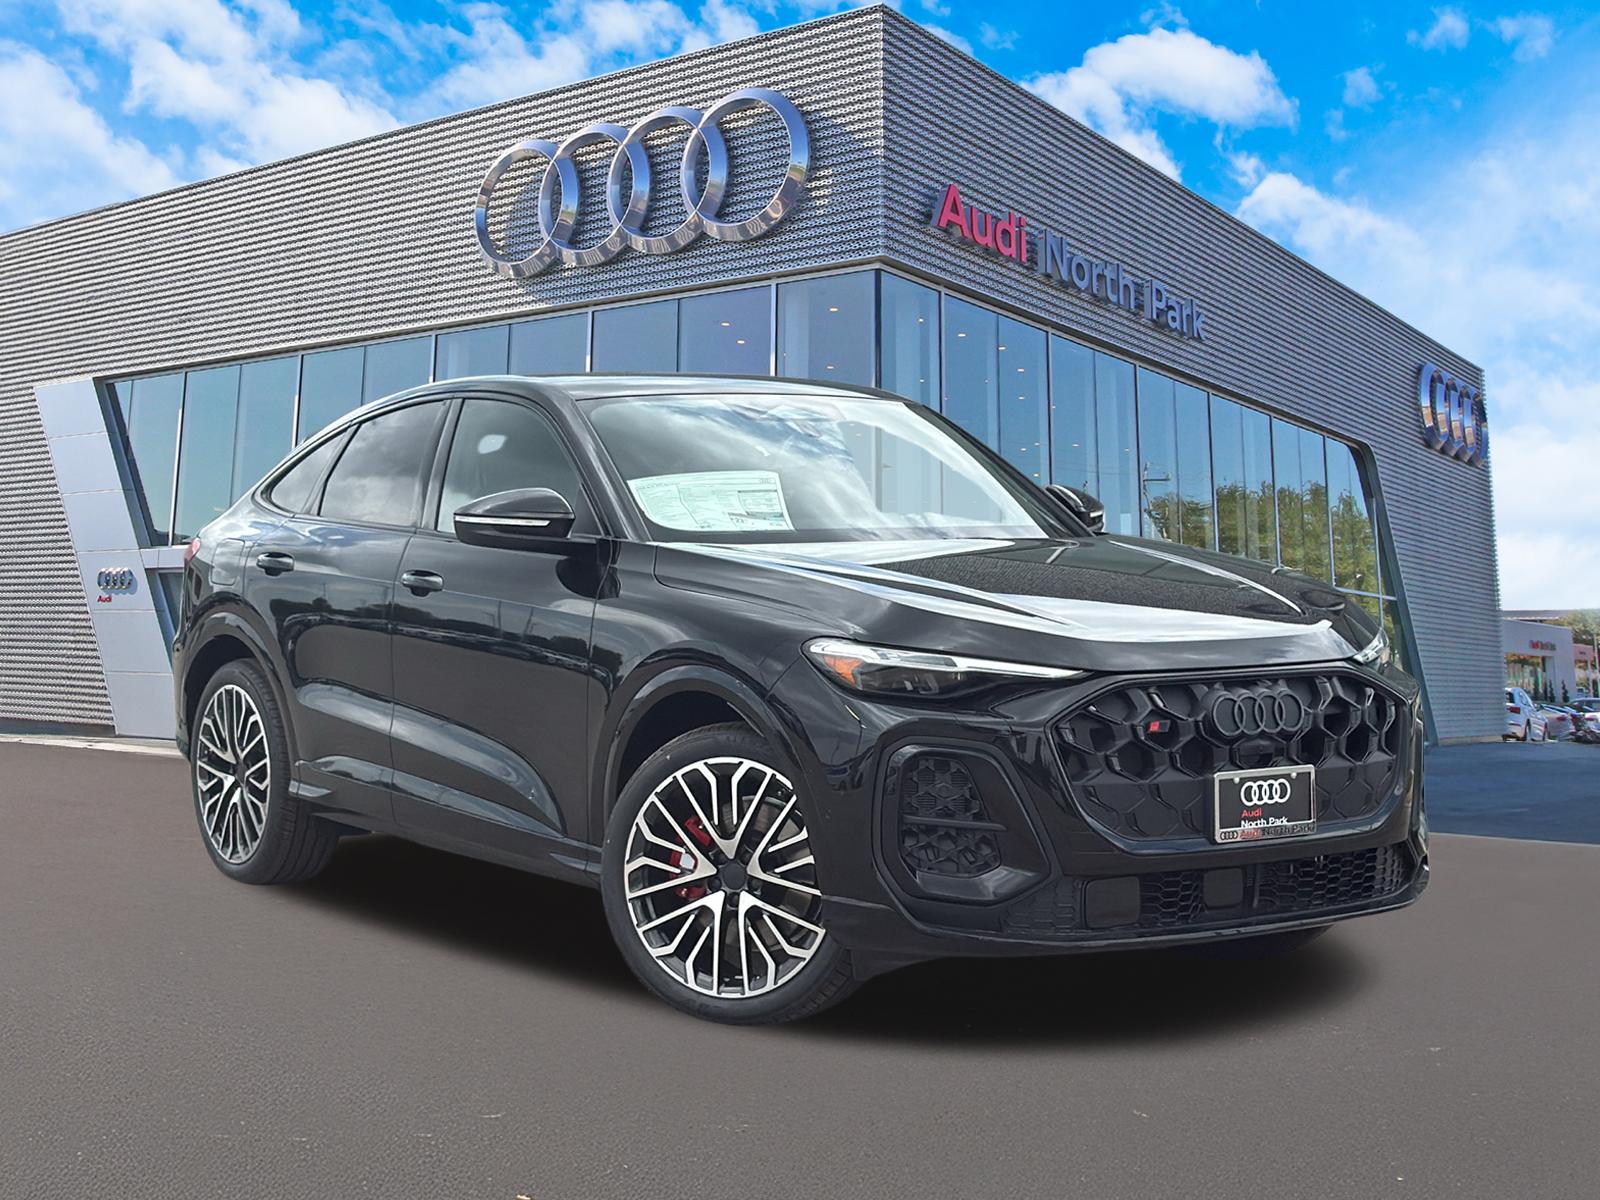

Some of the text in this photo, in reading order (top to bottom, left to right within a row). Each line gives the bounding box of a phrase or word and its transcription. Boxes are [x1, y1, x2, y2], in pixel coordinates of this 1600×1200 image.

[934, 183, 1208, 341] Audi North Park
[1242, 808, 1262, 817] Audi
[1241, 816, 1288, 828] North Park
